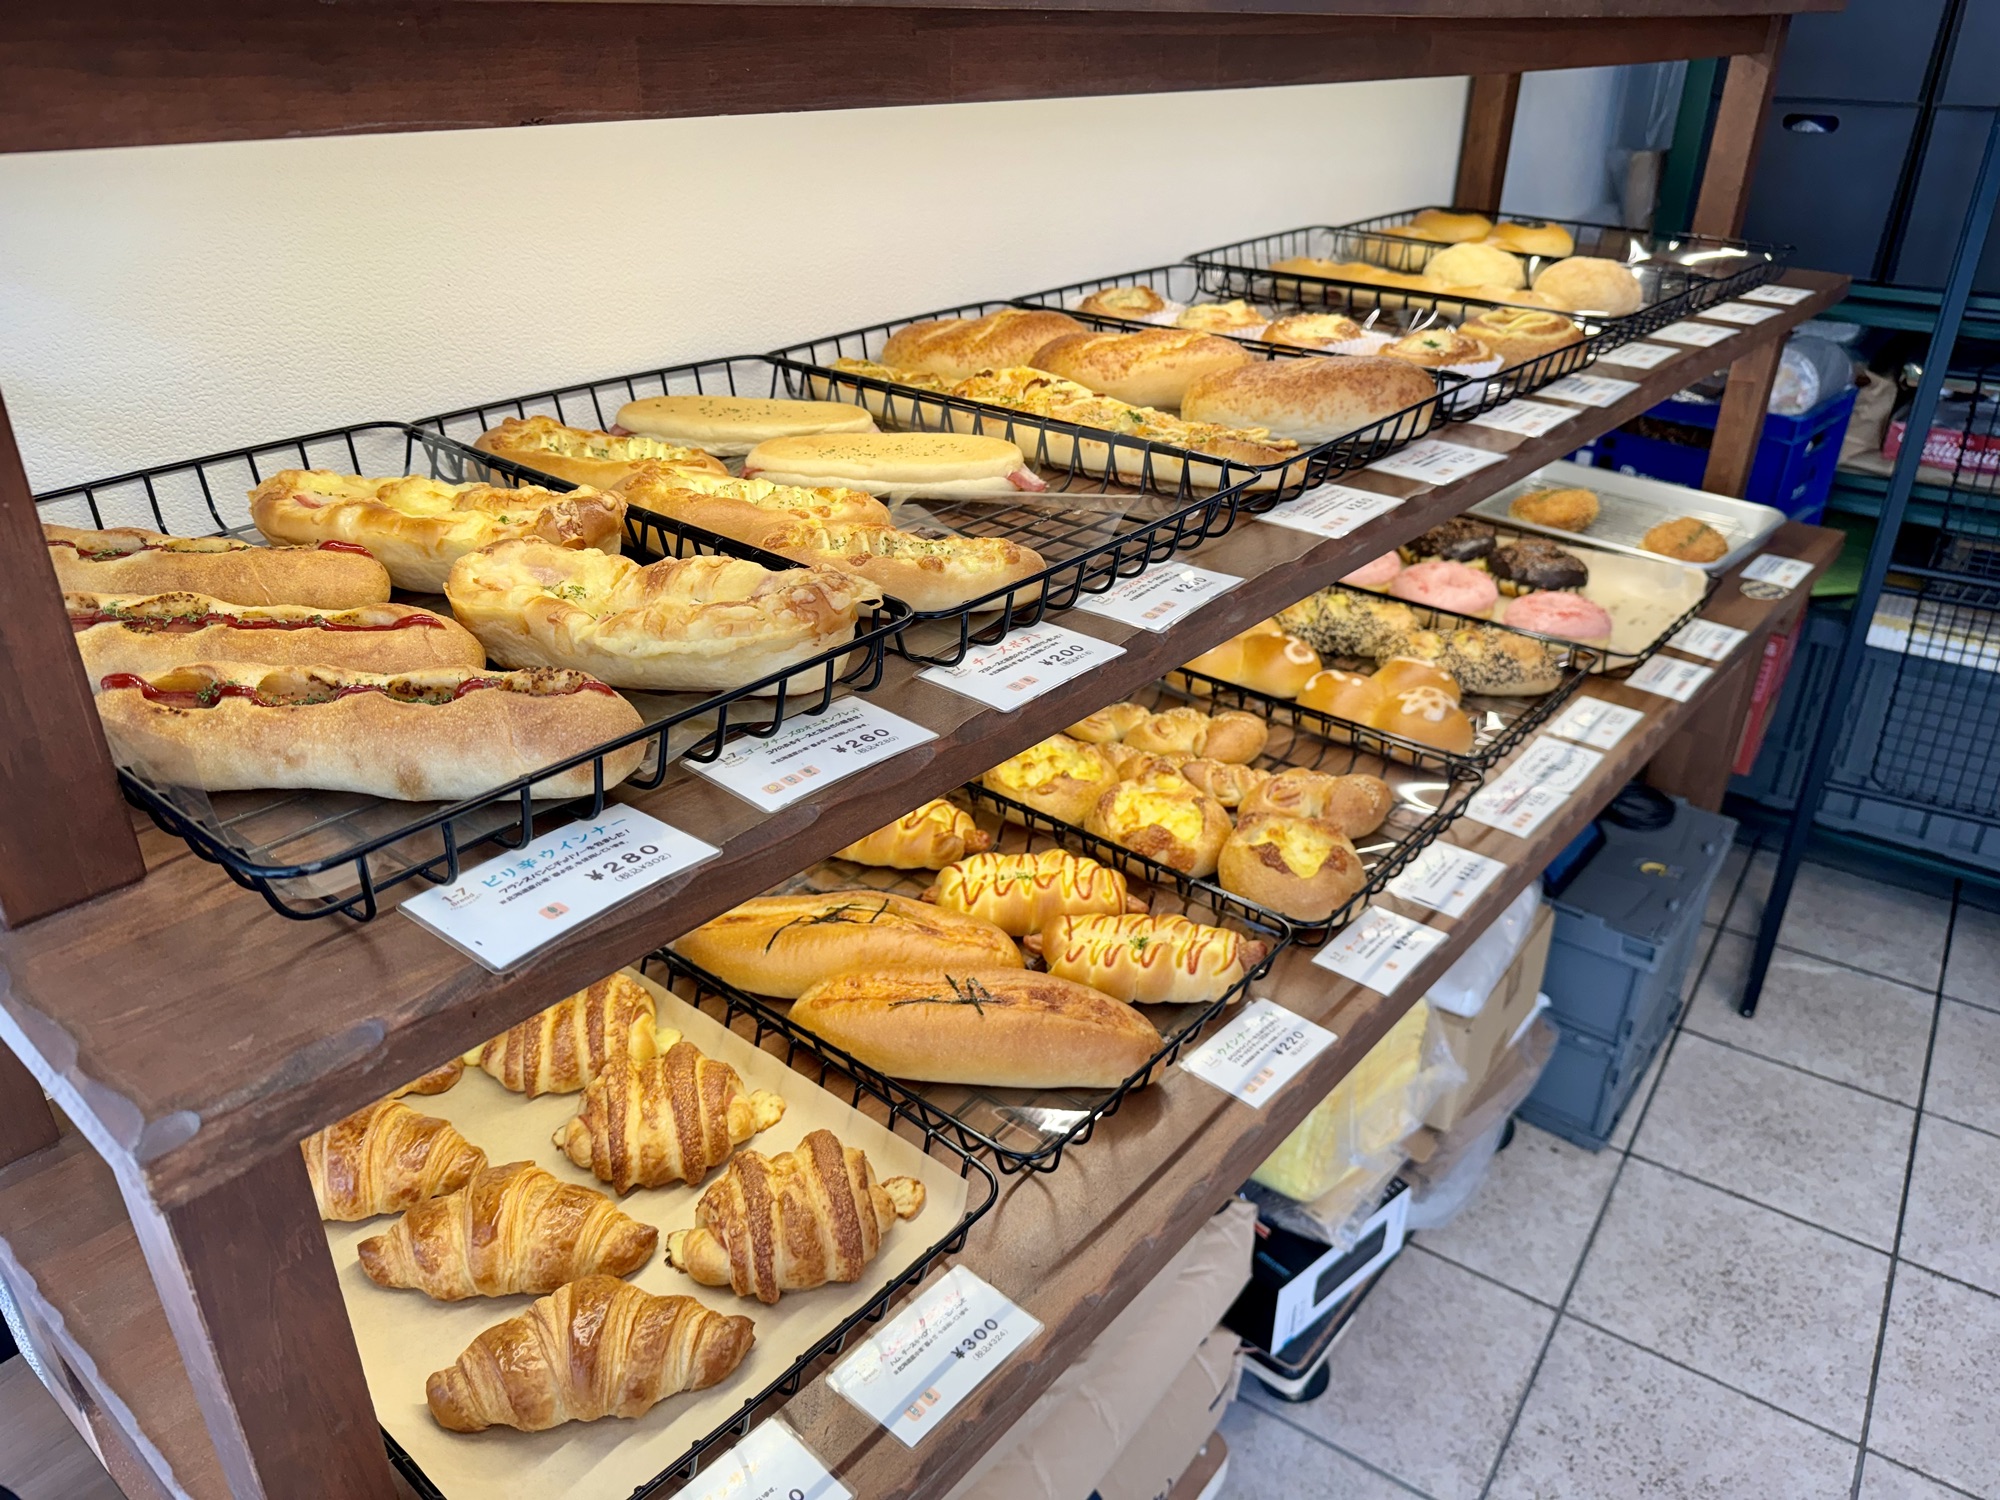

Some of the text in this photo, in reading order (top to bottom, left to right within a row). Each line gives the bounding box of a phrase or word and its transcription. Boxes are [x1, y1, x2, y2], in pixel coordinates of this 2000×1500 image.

[1037, 644, 1085, 667] ¥200
[829, 728, 890, 753] ¥260
[717, 751, 737, 763] 1-7
[481, 818, 626, 887] ピリ辛ウインナー
[584, 844, 660, 881] ¥280
[613, 852, 672, 882] (税込¥302)
[441, 887, 467, 904] 1-7
[1273, 1030, 1305, 1056] ¥220
[951, 1318, 998, 1360] ¥300
[972, 1329, 1008, 1361] (税込¥324)
